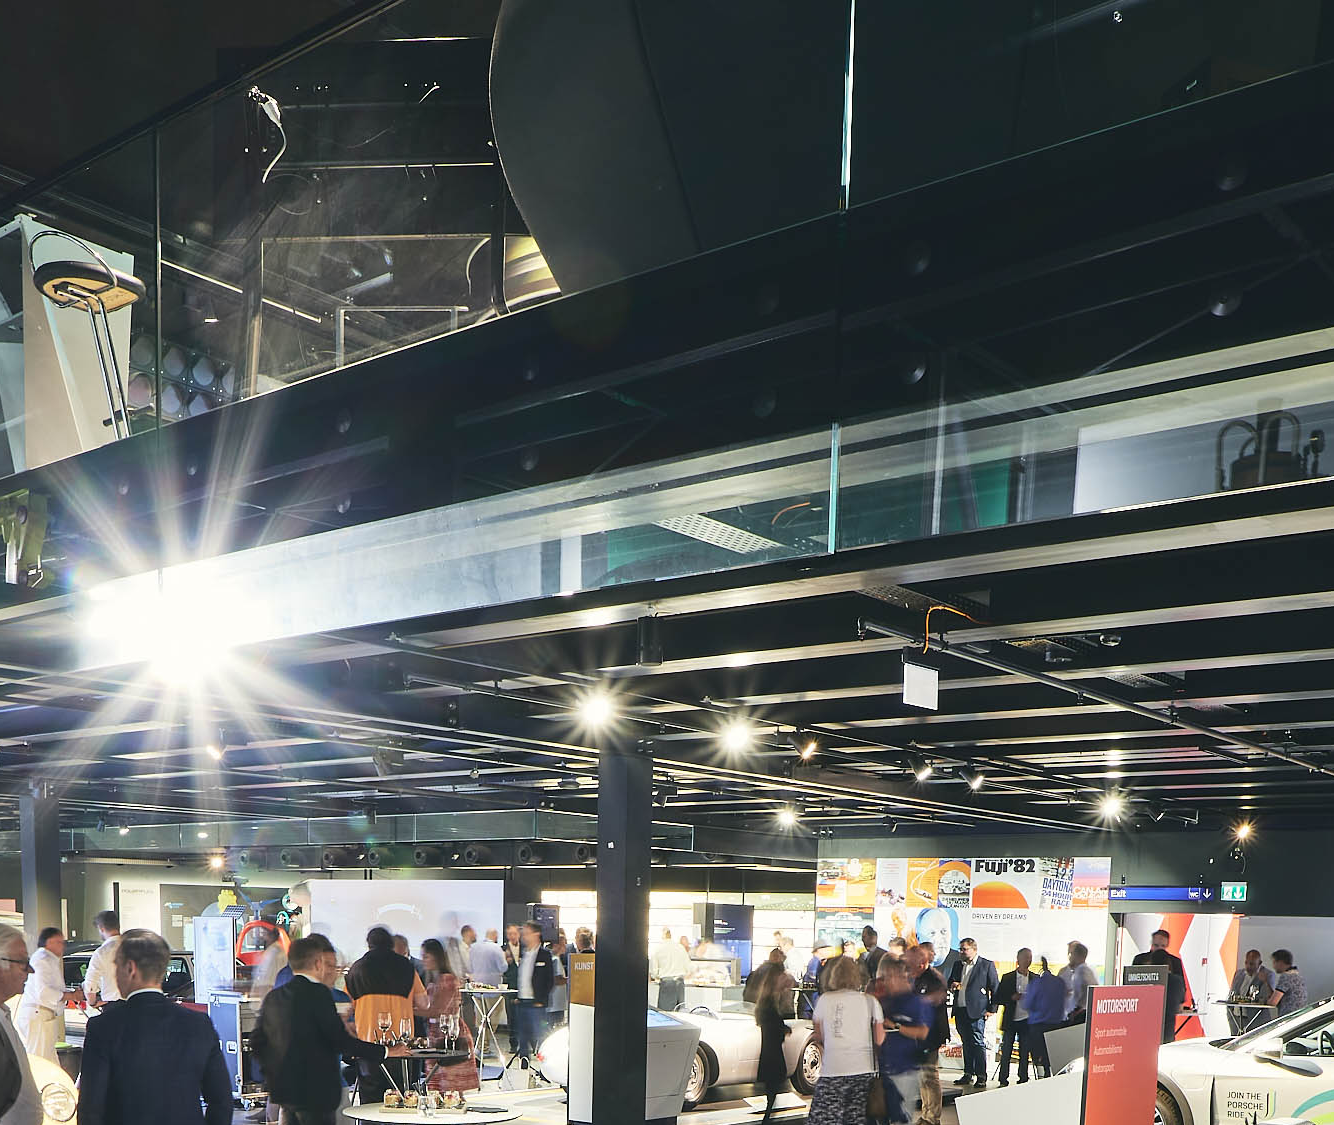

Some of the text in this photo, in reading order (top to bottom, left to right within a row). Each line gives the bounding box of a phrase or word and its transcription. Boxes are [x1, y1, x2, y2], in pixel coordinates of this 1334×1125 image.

[1042, 877, 1073, 893] DAYTONA
[1110, 889, 1126, 898] Exit
[1051, 898, 1070, 907] RACE
[575, 962, 594, 970] KUNST
[1096, 999, 1139, 1014] MOTORSPORT
[1227, 1091, 1262, 1101] JOIN THE
[1227, 1101, 1264, 1111] PORSCHE
[1227, 1110, 1245, 1119] RIDE
